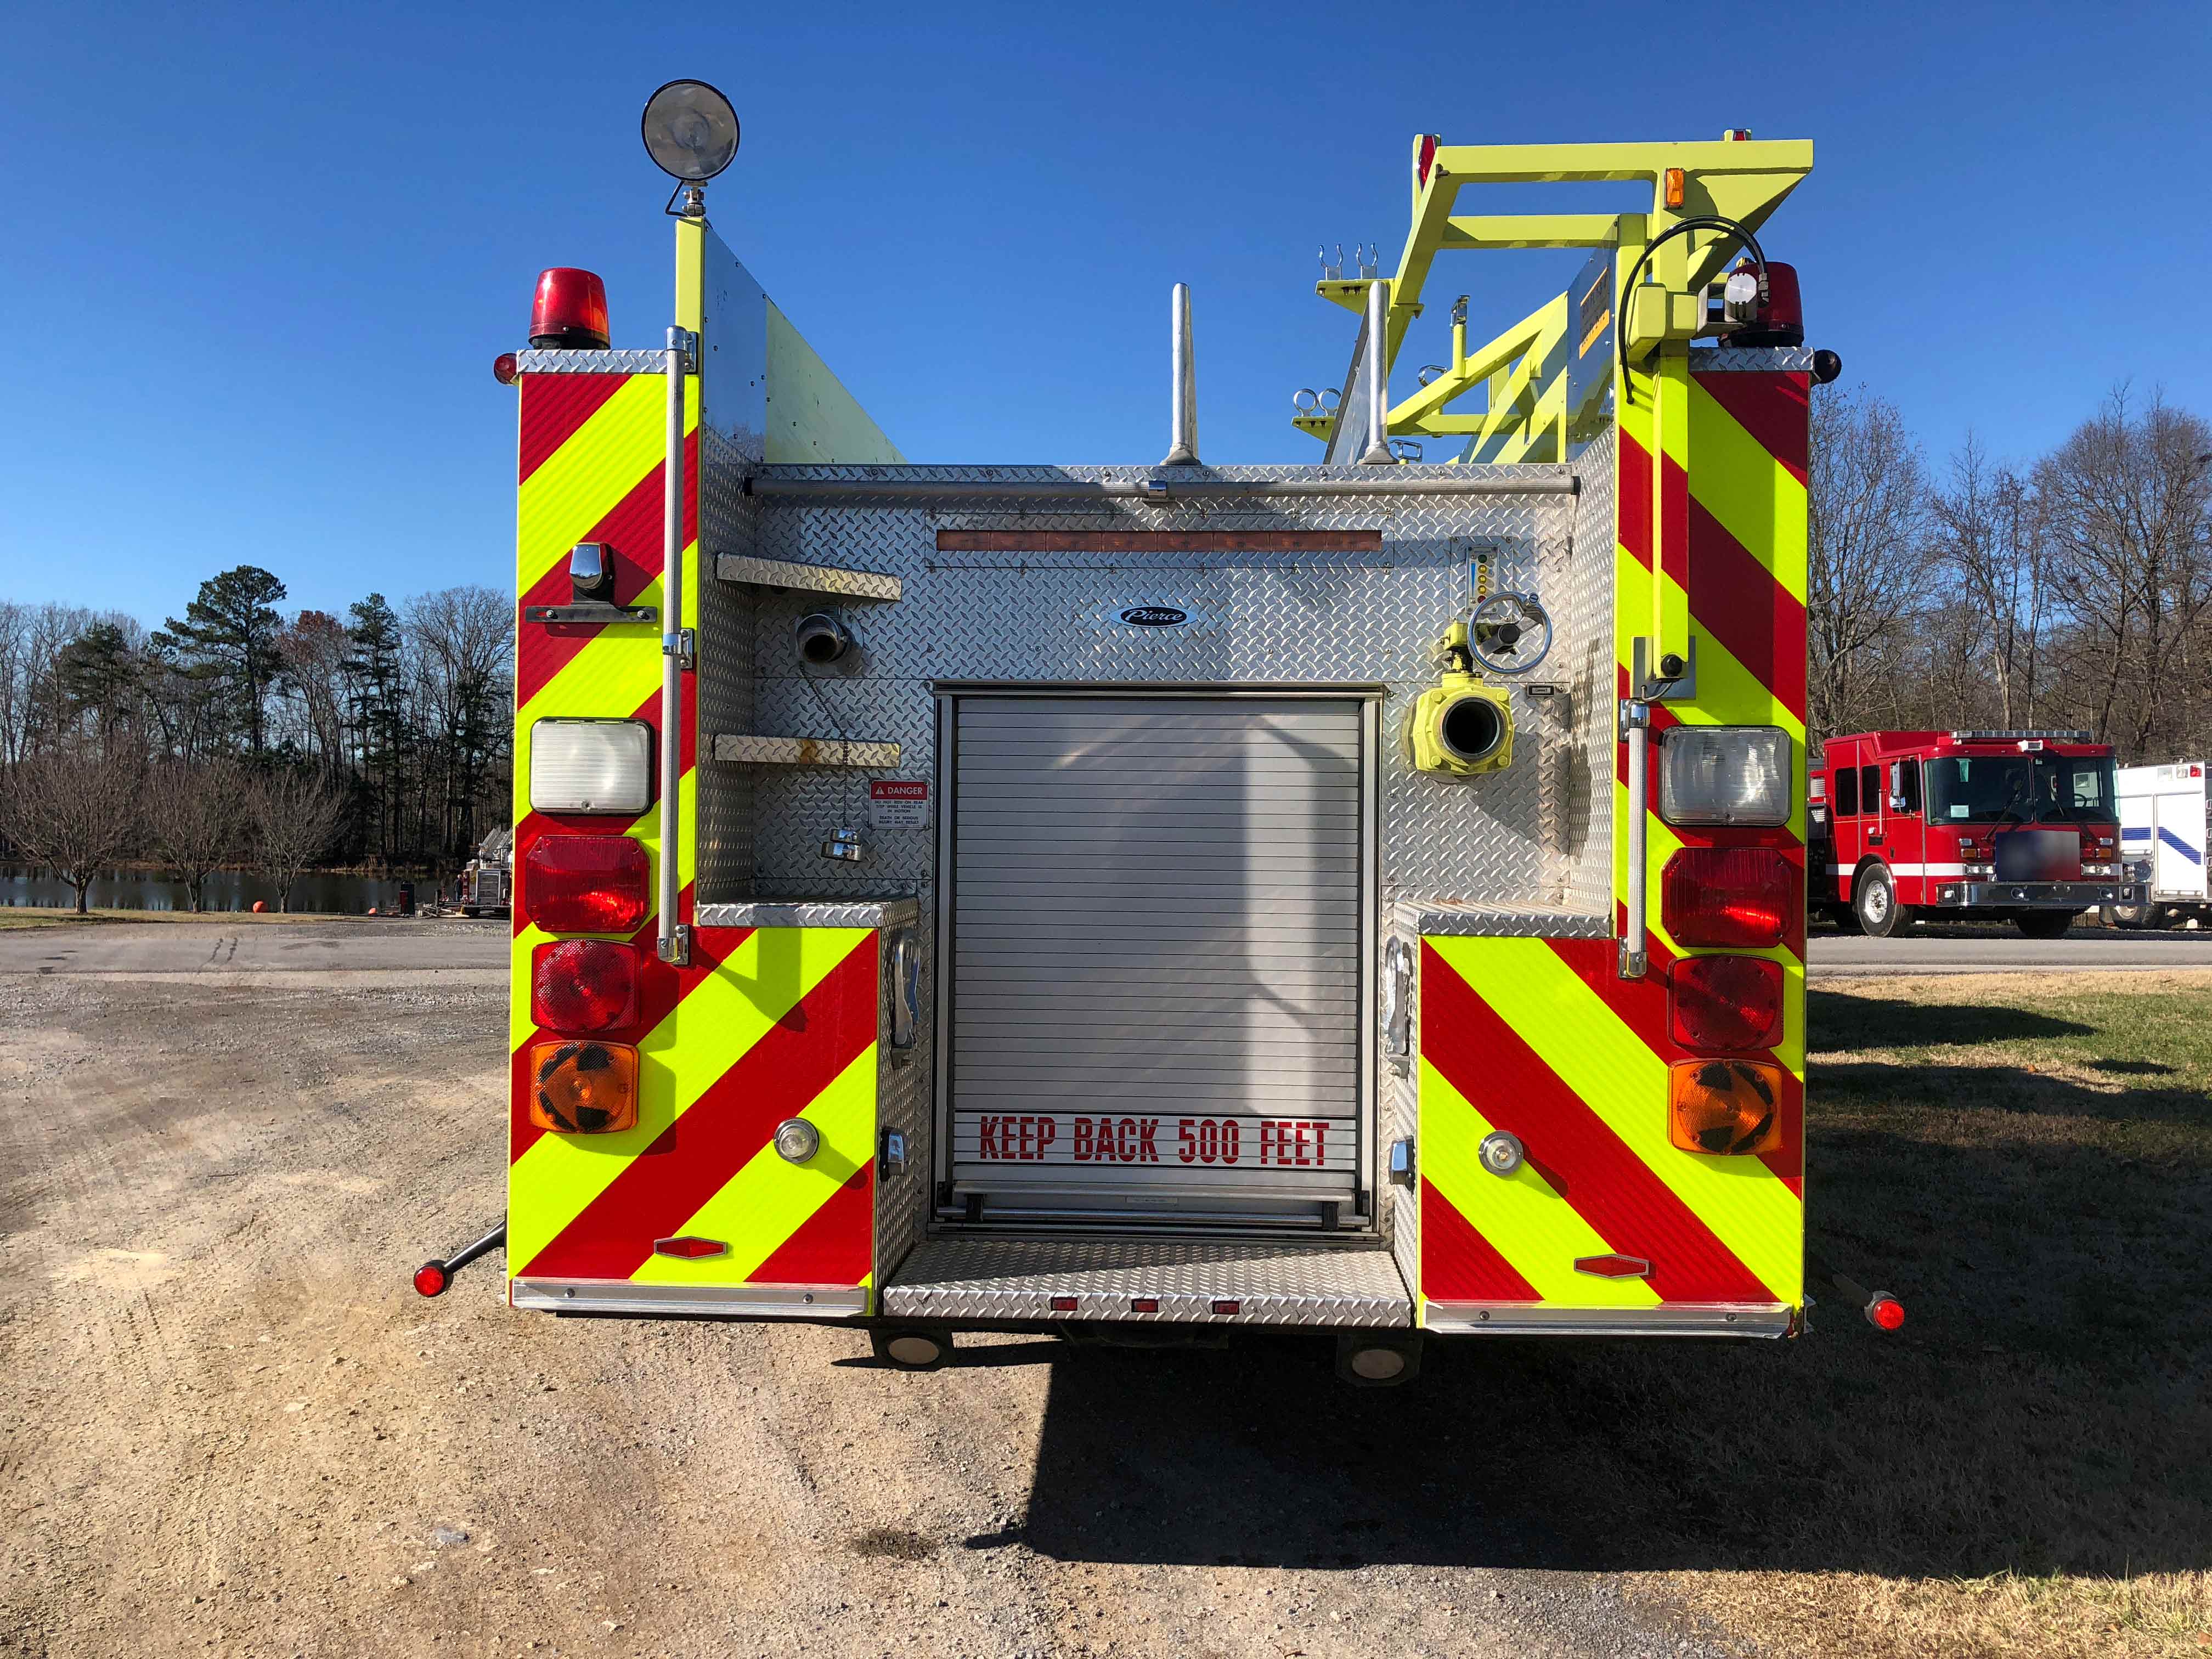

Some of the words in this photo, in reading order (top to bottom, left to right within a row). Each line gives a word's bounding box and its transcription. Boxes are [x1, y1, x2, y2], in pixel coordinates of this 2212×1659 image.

[1125, 610, 1183, 621] Pierce
[888, 787, 923, 795] DANGER
[980, 1116, 1056, 1160] KEEP
[1074, 1118, 1159, 1162] BACK
[1178, 1119, 1239, 1163] 500
[1260, 1121, 1330, 1166] FEET
